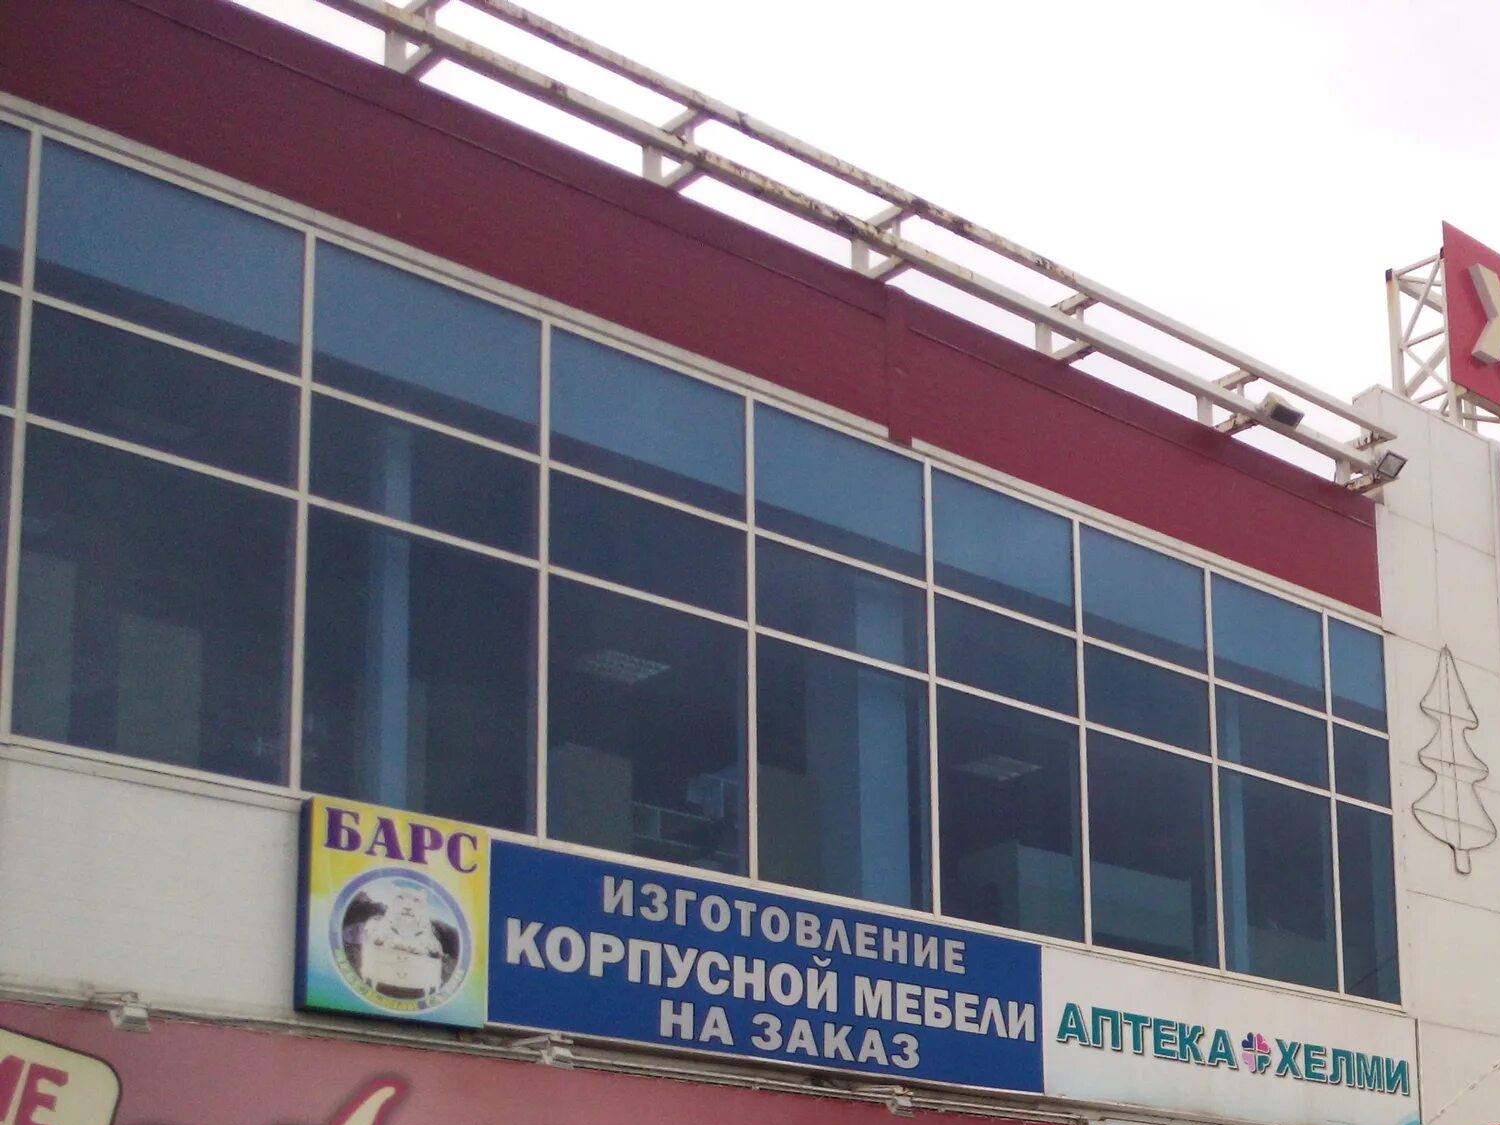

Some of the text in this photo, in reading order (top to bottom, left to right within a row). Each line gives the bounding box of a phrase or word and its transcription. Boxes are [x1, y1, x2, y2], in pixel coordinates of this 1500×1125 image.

[324, 806, 478, 873] БАРС
[603, 875, 967, 975] ИЗГОТОВЛЕНИЕ
[506, 918, 838, 1012] КОРПУСНОЙ
[853, 975, 1037, 1043] МЕБЕЛИ
[660, 999, 921, 1069] НА ЗАКАЗ
[1055, 1002, 1410, 1096] АПТЕКА ХЕЛМИ
